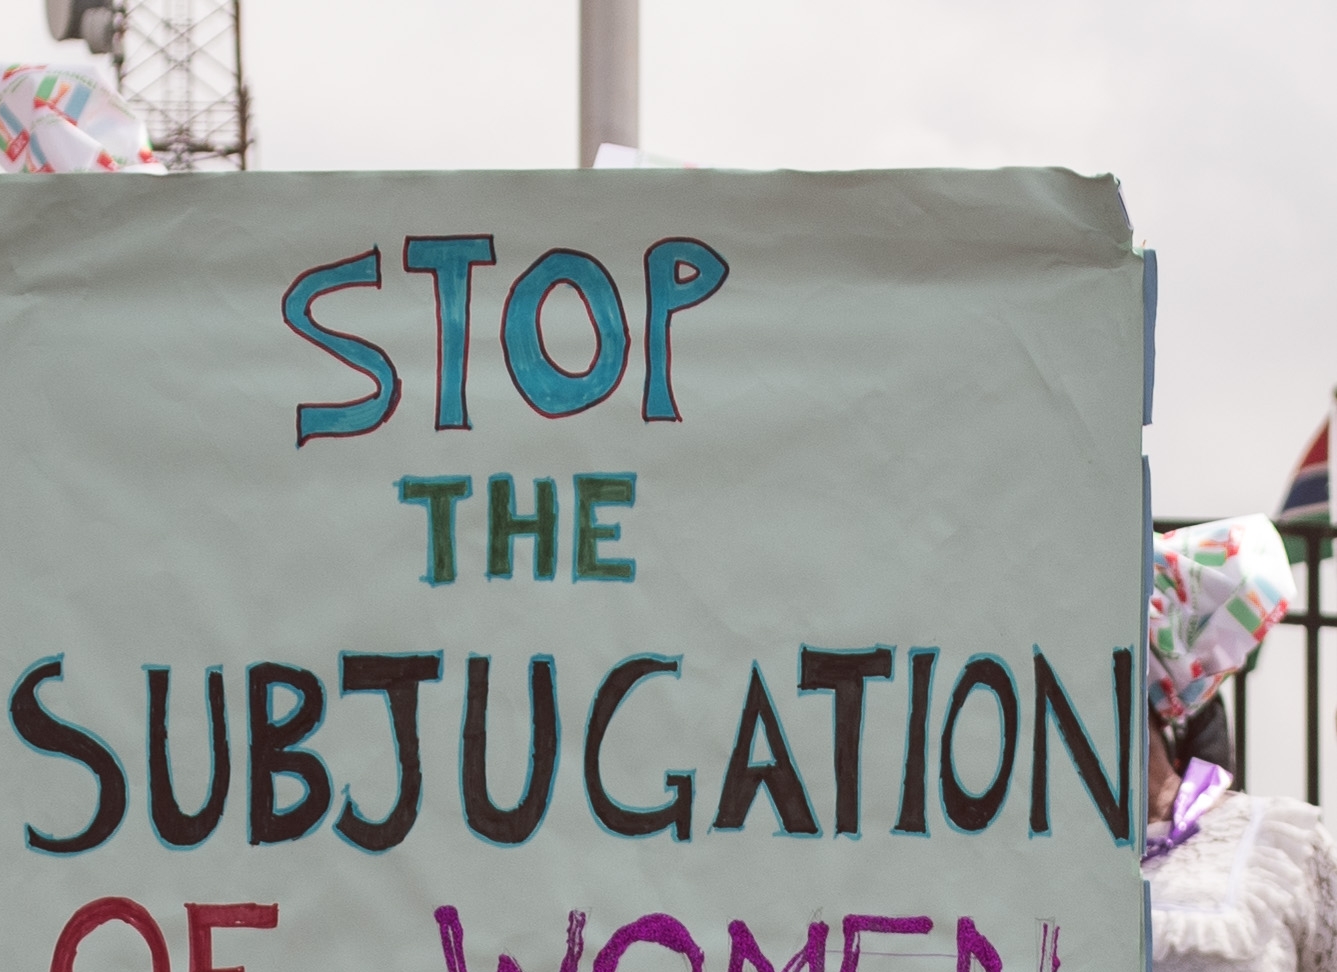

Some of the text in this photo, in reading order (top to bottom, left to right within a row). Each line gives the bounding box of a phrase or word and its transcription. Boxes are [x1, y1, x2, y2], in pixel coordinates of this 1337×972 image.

[281, 233, 730, 449] STOP
[393, 472, 638, 587] THE
[8, 642, 1137, 858] SUBJUGATION
